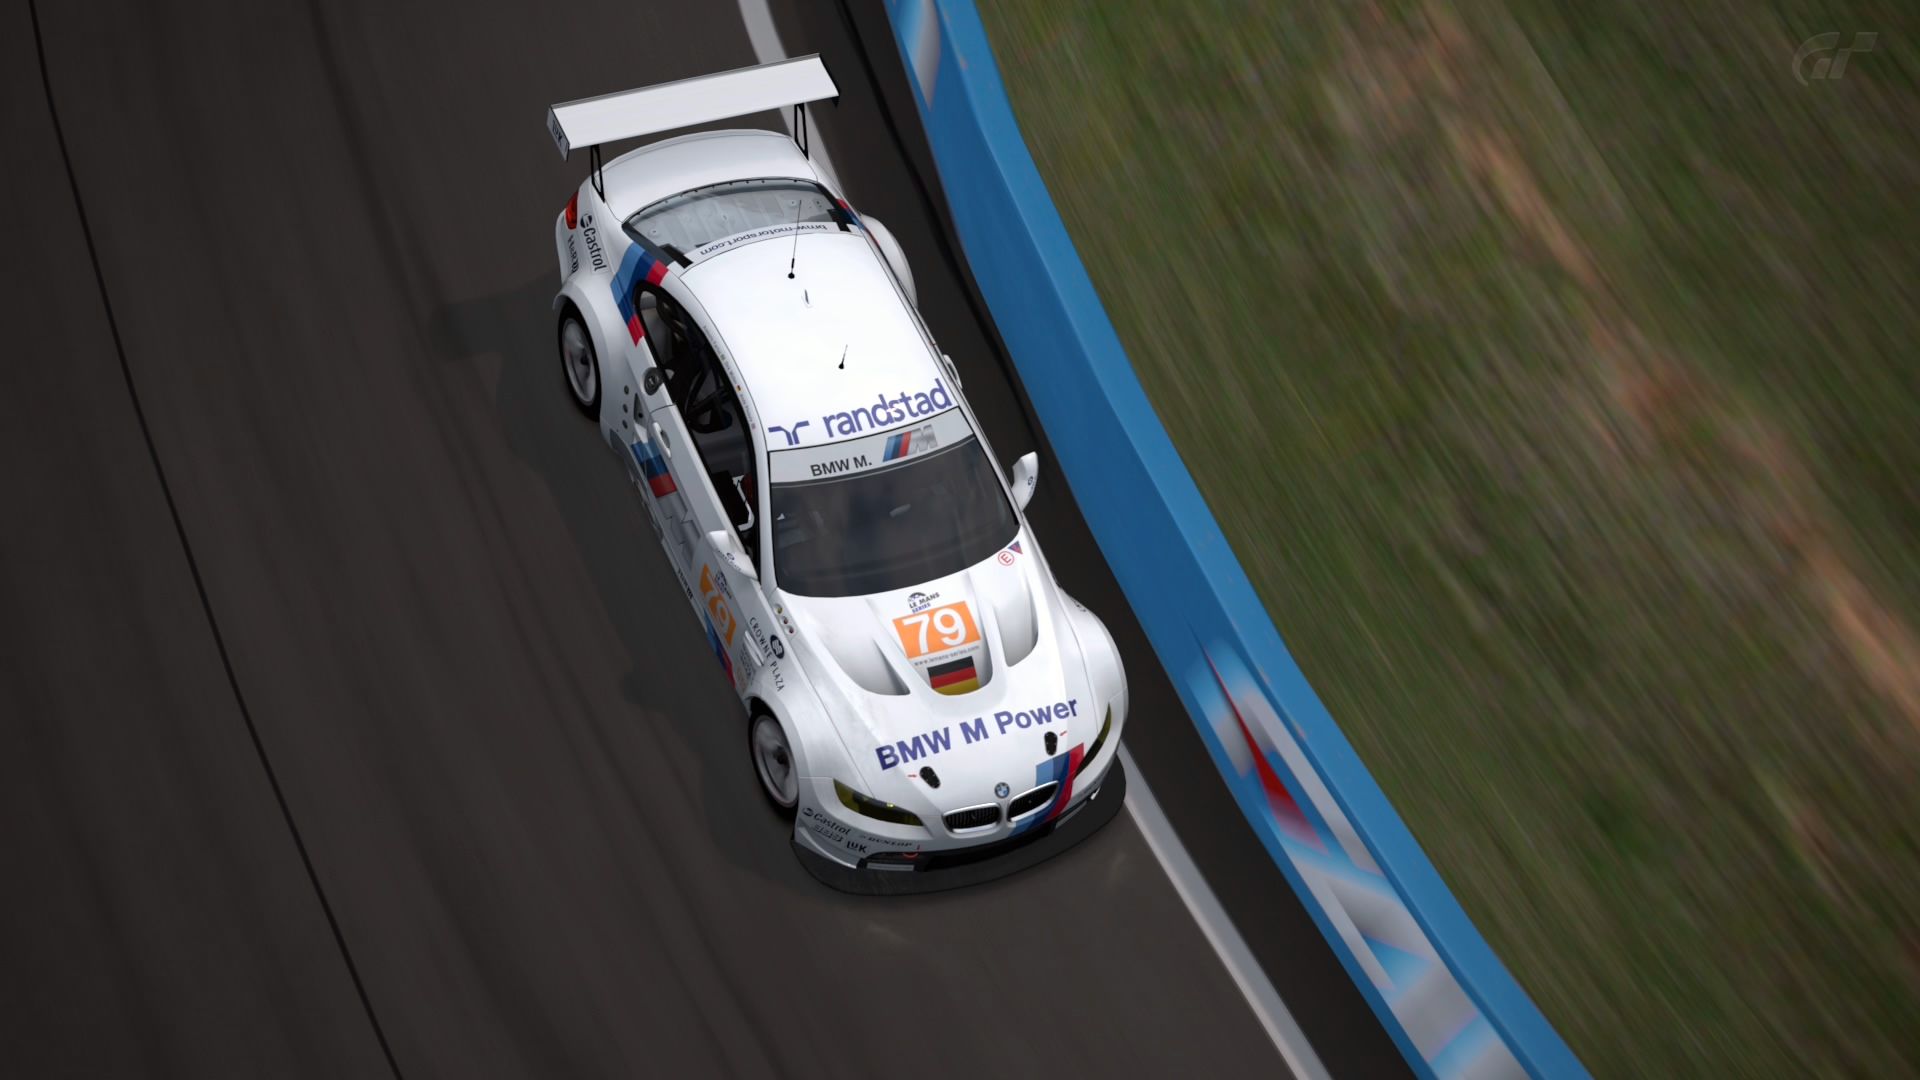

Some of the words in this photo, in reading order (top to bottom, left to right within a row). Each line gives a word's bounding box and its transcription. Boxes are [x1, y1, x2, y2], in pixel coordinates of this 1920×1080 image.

[583, 228, 607, 272] Castrol
[700, 223, 828, 256] bmw-motorsport.com
[822, 378, 953, 438] randstad
[810, 458, 850, 477] BMW
[853, 454, 873, 470] M.
[912, 602, 932, 613] SERIES
[919, 592, 941, 604] MANS
[902, 608, 968, 655] 79
[749, 617, 774, 659] CROWNE
[770, 661, 785, 692] PLAZA
[875, 727, 951, 770] BMW
[959, 717, 990, 744] M
[994, 699, 1078, 735] Power
[814, 814, 852, 835] Castrol
